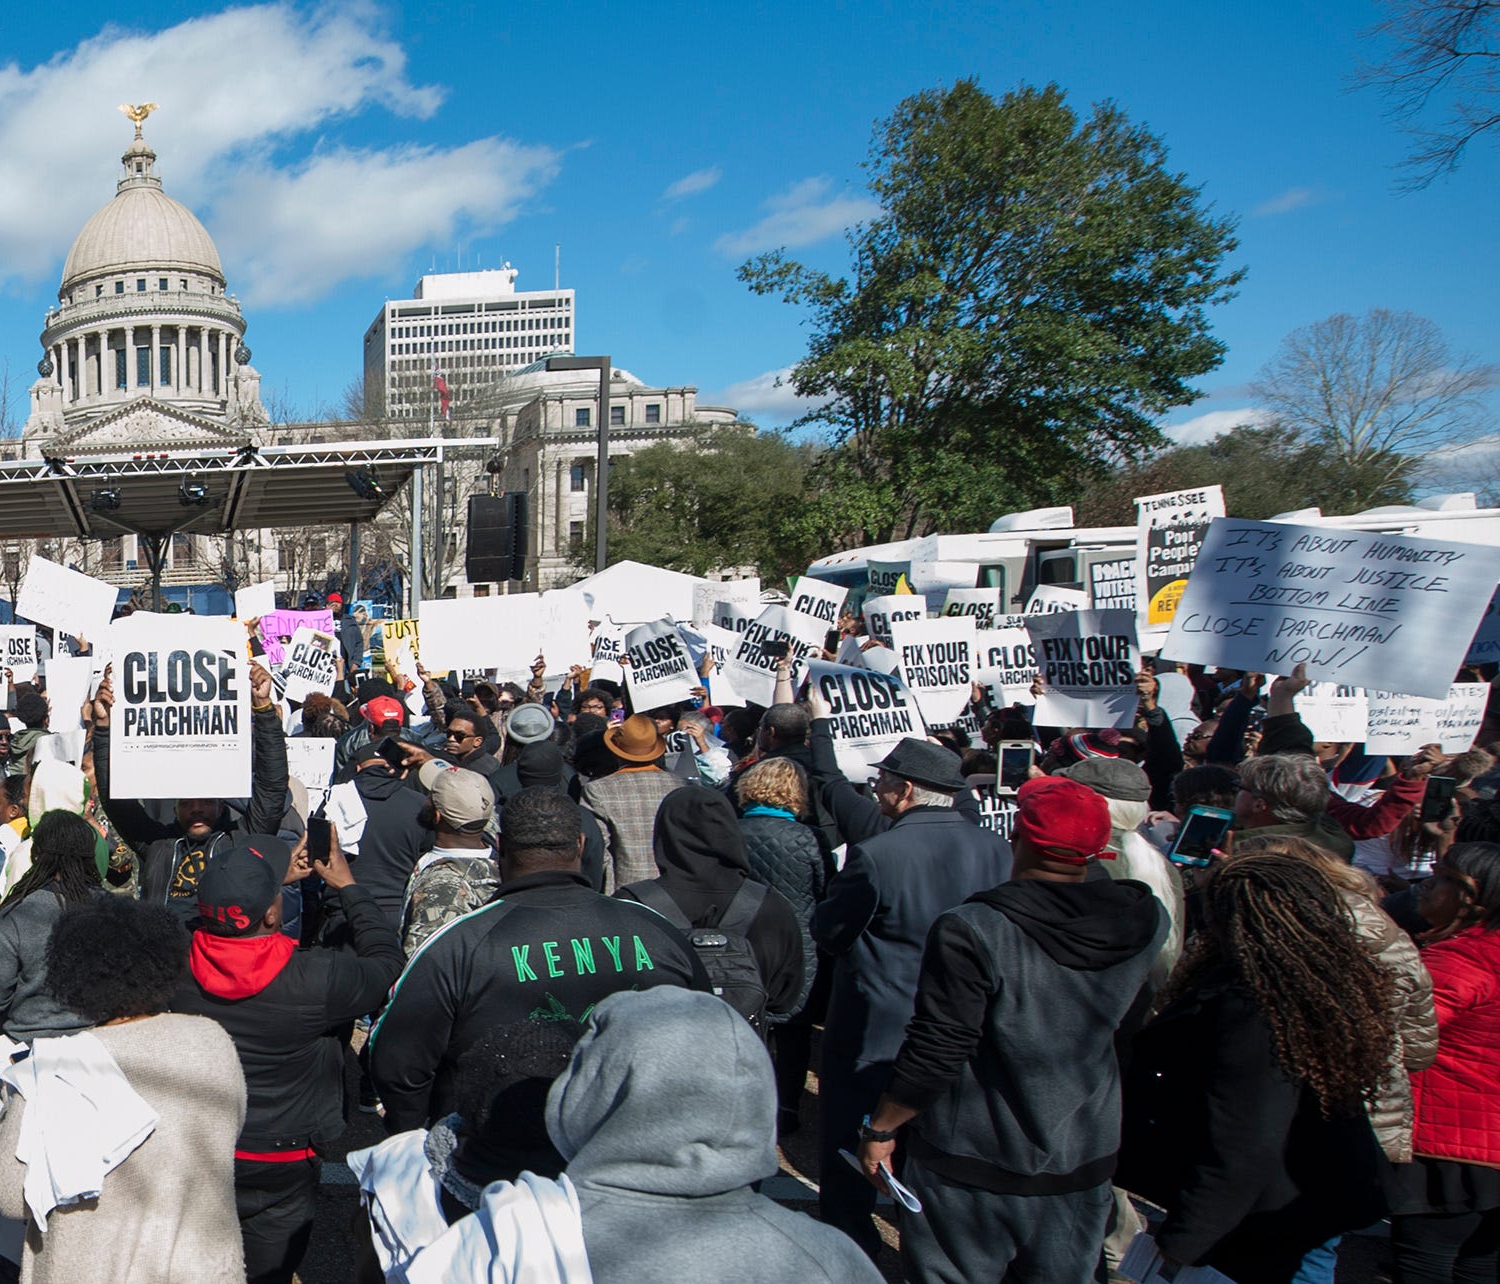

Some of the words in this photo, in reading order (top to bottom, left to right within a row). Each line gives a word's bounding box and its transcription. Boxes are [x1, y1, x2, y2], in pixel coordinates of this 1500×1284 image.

[1143, 492, 1207, 512] TENNESSEE
[1150, 541, 1202, 562] People'
[1165, 530, 1195, 546] Poor
[1290, 533, 1359, 555] ABOUT
[1362, 541, 1466, 566] HUMANITY
[1148, 559, 1194, 577] Campai
[1276, 561, 1336, 580] ABOUT
[1343, 565, 1449, 593] JUSTICE
[1249, 583, 1330, 606] BOTTOM
[1336, 591, 1401, 613] LINE
[385, 619, 419, 639] JUST
[744, 622, 772, 644] FIX
[1181, 613, 1266, 637] CLOSE
[1275, 616, 1404, 645] PARCHMAN
[7, 656, 34, 666] CHMAN
[8, 638, 31, 656] OSE
[627, 633, 683, 670] CLOSE
[736, 641, 804, 679] PRISOS
[903, 645, 925, 667] FIX
[927, 641, 969, 665] YOUR
[988, 644, 1037, 670] CLOS
[1041, 637, 1071, 661] FIX
[1073, 635, 1130, 661] YOUR
[1263, 638, 1370, 675] NOW!
[124, 649, 238, 704] CLOSE
[632, 656, 689, 685] PARCHMAN
[905, 663, 970, 688] PRISONS
[1045, 660, 1135, 687] PRISONS
[820, 671, 907, 715] CLOSE
[124, 705, 238, 736] PARCHMAN
[829, 709, 913, 740] PARCHMAN
[510, 934, 655, 983] KENYA
